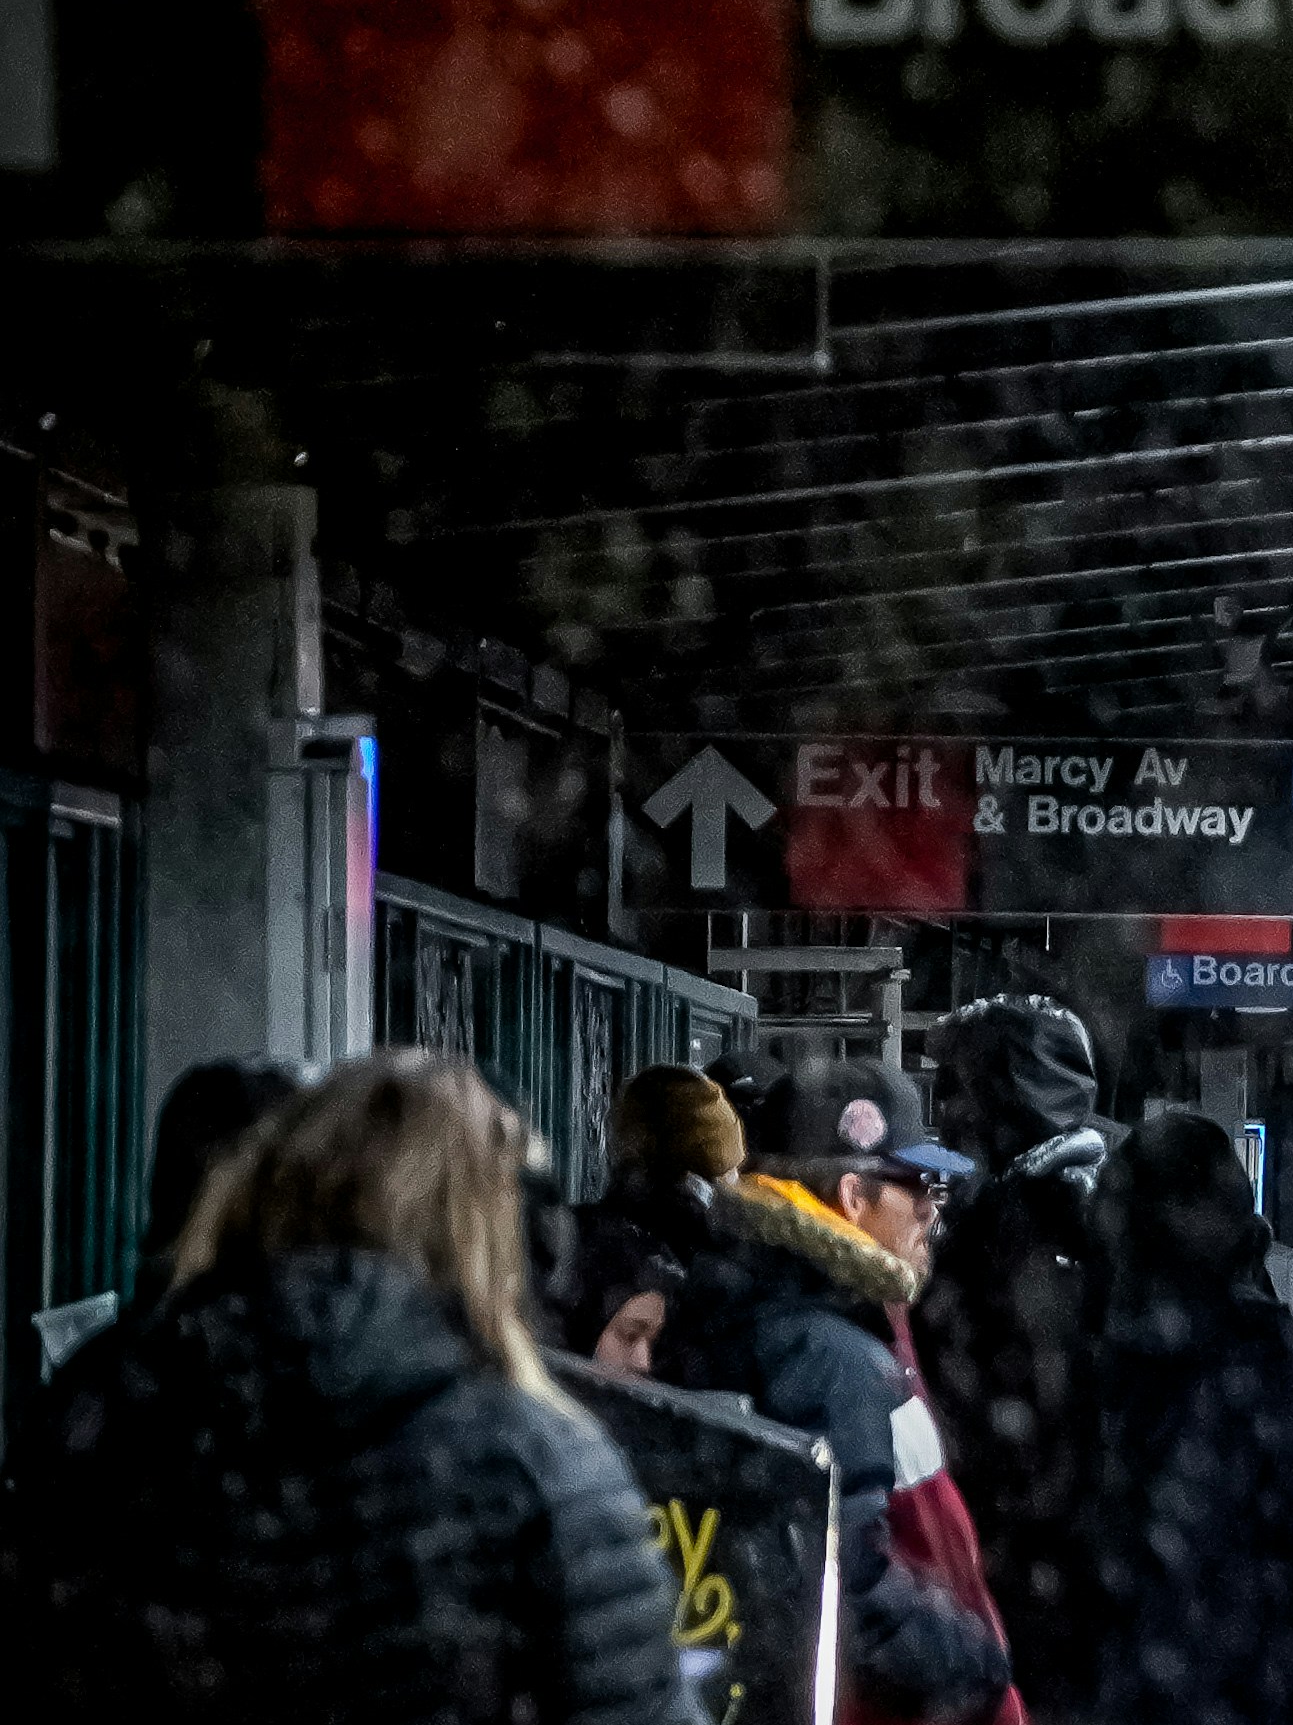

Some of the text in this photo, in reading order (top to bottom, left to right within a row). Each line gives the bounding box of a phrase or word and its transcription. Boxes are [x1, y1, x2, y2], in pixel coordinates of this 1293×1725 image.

[797, 743, 941, 808] Exit
[975, 745, 1190, 793] Marcy Av
[972, 794, 1255, 845] & Broadway
